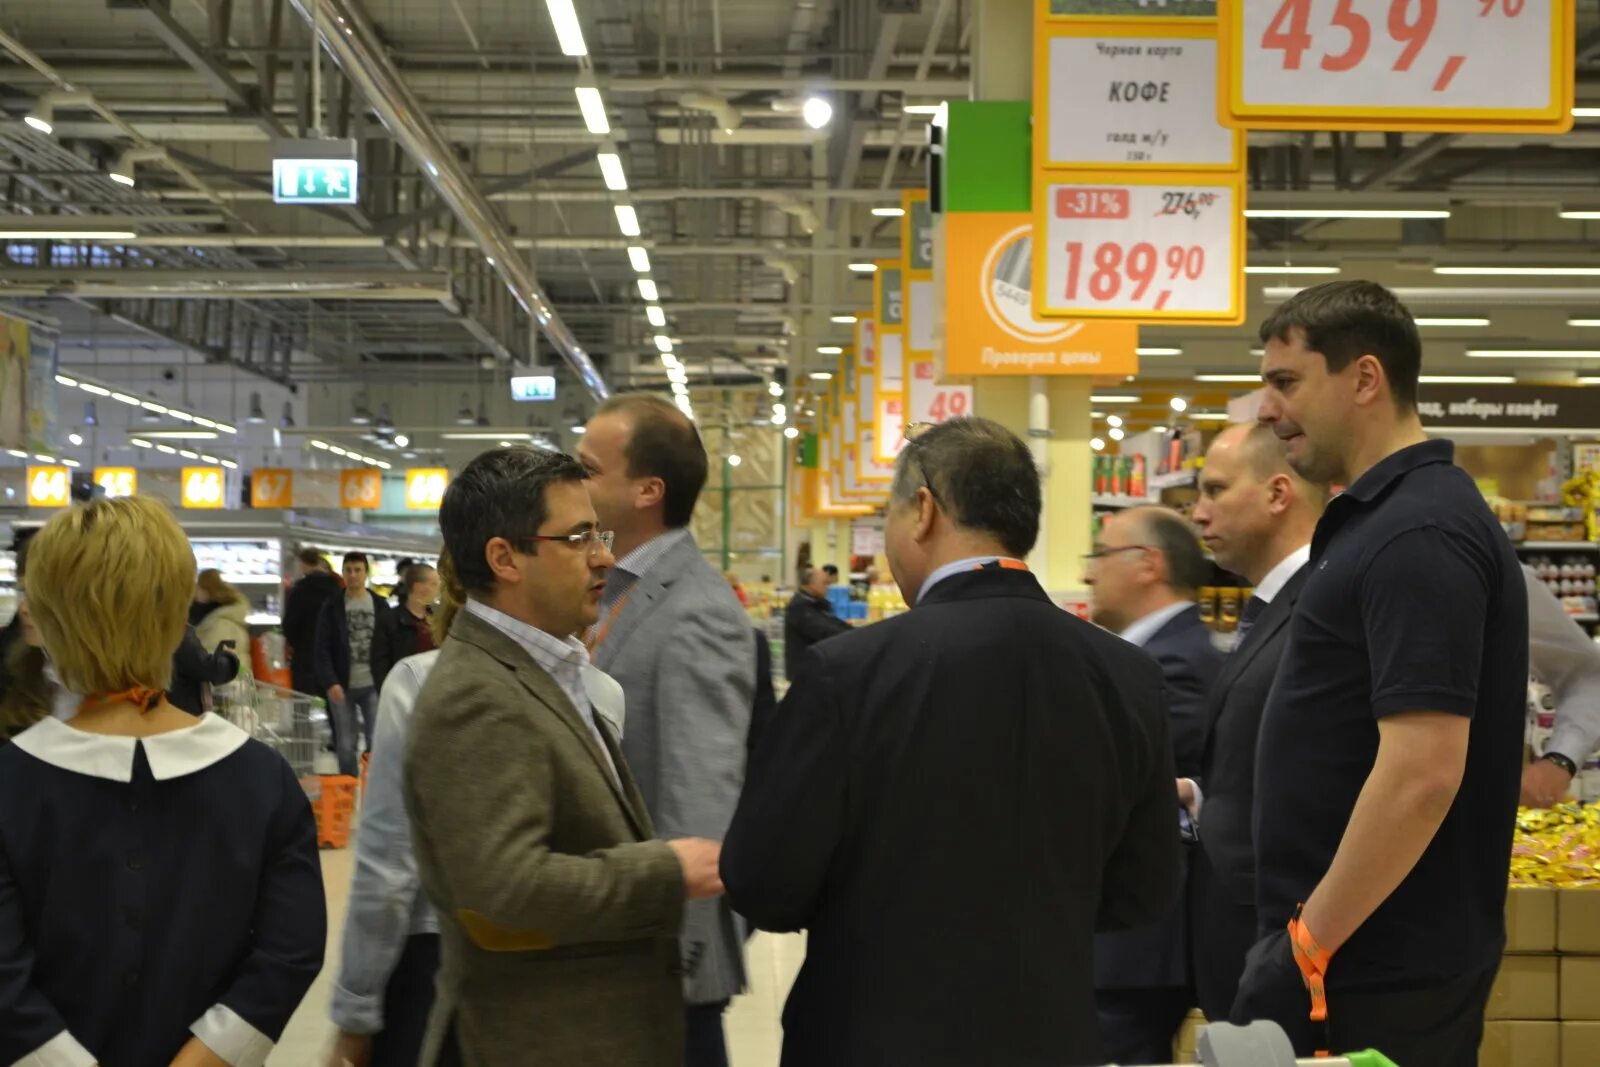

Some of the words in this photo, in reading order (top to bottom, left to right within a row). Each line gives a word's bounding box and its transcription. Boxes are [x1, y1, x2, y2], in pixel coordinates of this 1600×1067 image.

[1109, 81, 1170, 102] КОФЕ
[1066, 191, 1121, 214] -31%
[1064, 241, 1205, 310] 189,90
[981, 347, 1056, 368] Проверка
[1060, 352, 1102, 366] цены
[1449, 398, 1504, 420] наборы
[1506, 399, 1559, 420] конфет
[31, 470, 67, 501] 64
[185, 471, 221, 503] 66
[258, 474, 288, 501] 67
[344, 474, 376, 501] 68
